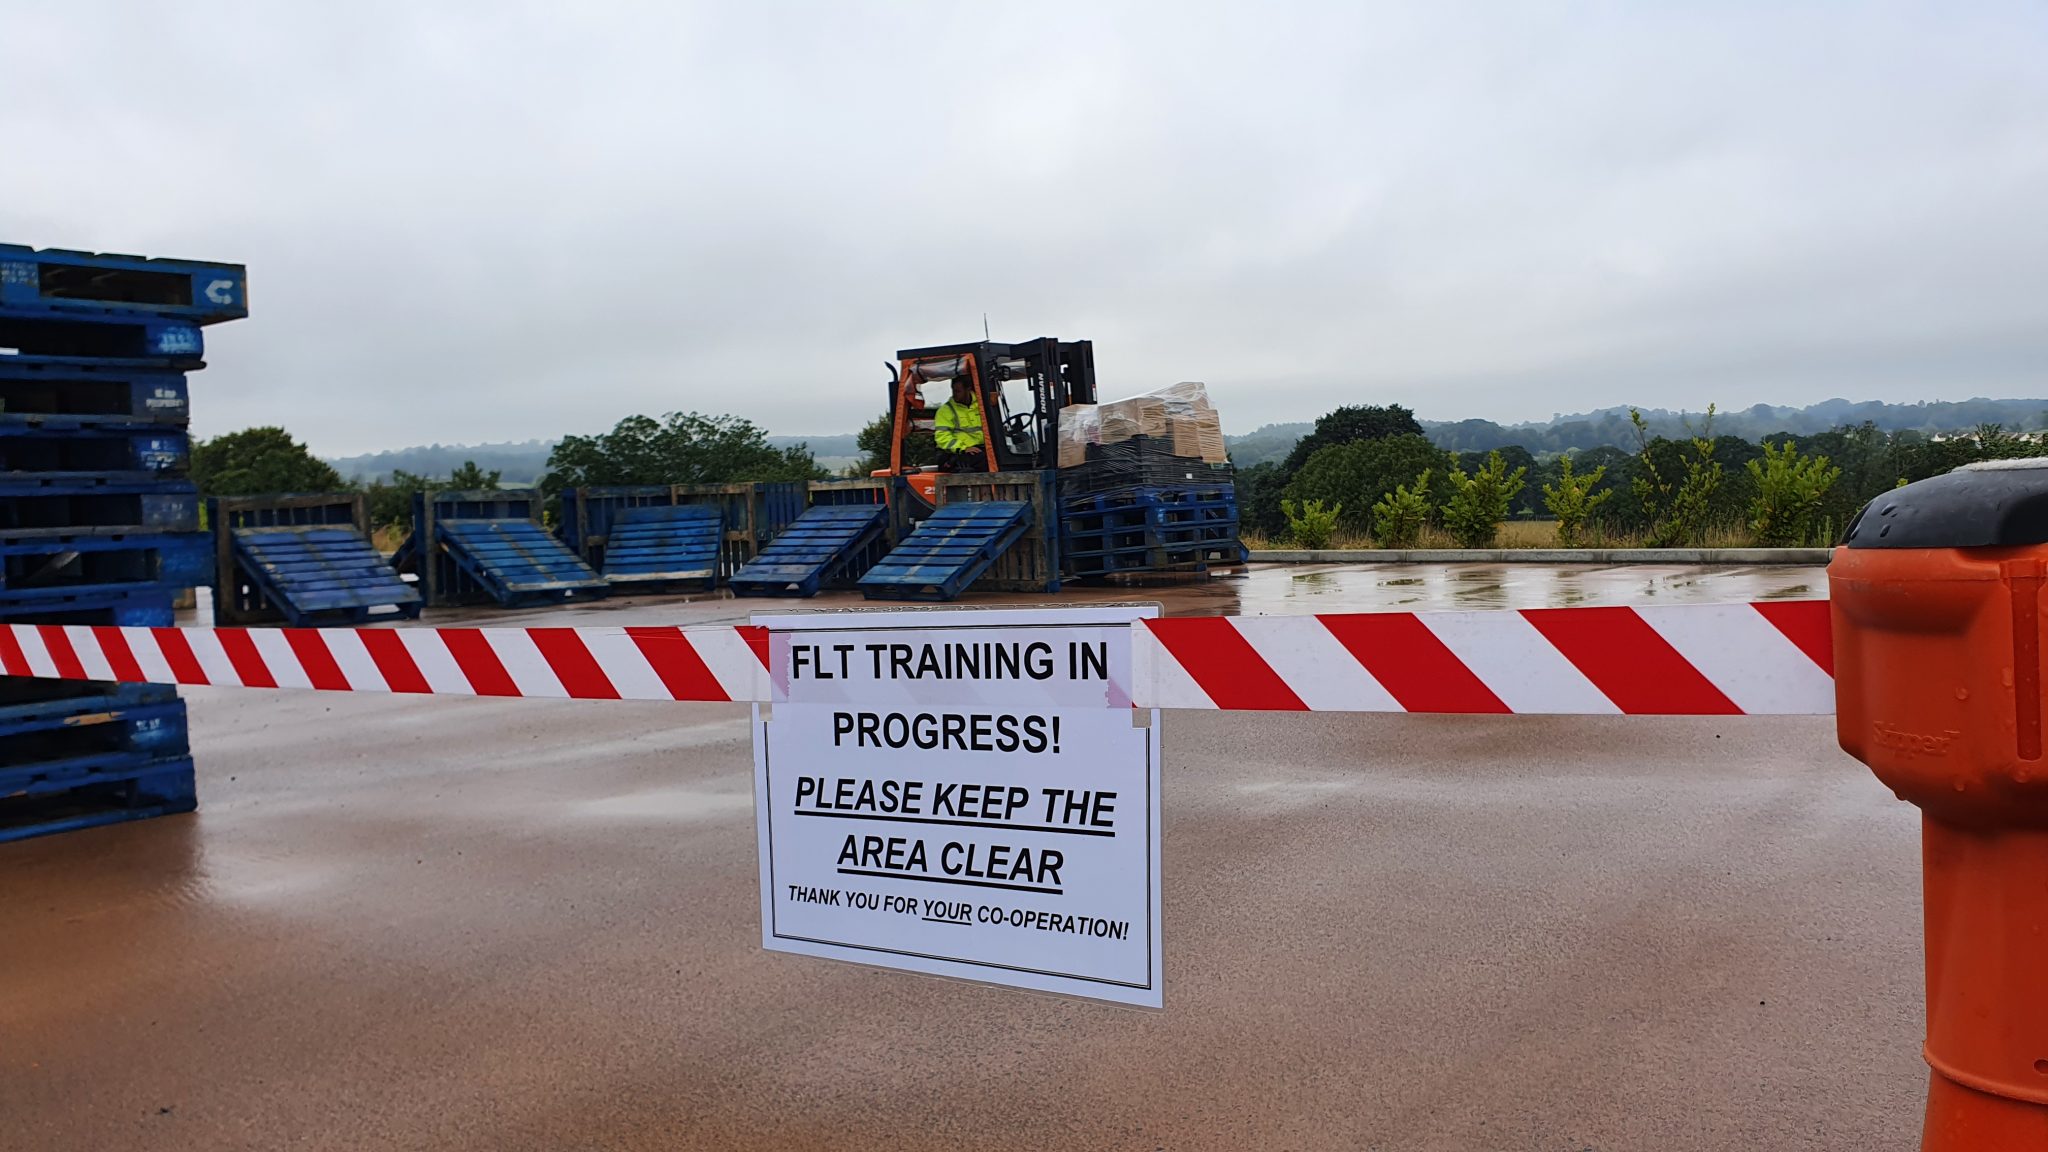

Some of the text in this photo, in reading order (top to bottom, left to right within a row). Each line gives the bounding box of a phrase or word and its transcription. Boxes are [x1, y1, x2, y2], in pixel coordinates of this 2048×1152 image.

[1038, 373, 1047, 413] DOOSAN
[792, 641, 1109, 681] FLT TRAINING IN
[833, 711, 1061, 755] PROGRESS!
[794, 776, 1118, 828] PLEASE KEEP THE
[836, 834, 1064, 886] AREA CLEAR
[788, 885, 1131, 941] THANK YOU FOR YOUR CO-OPERATION!
